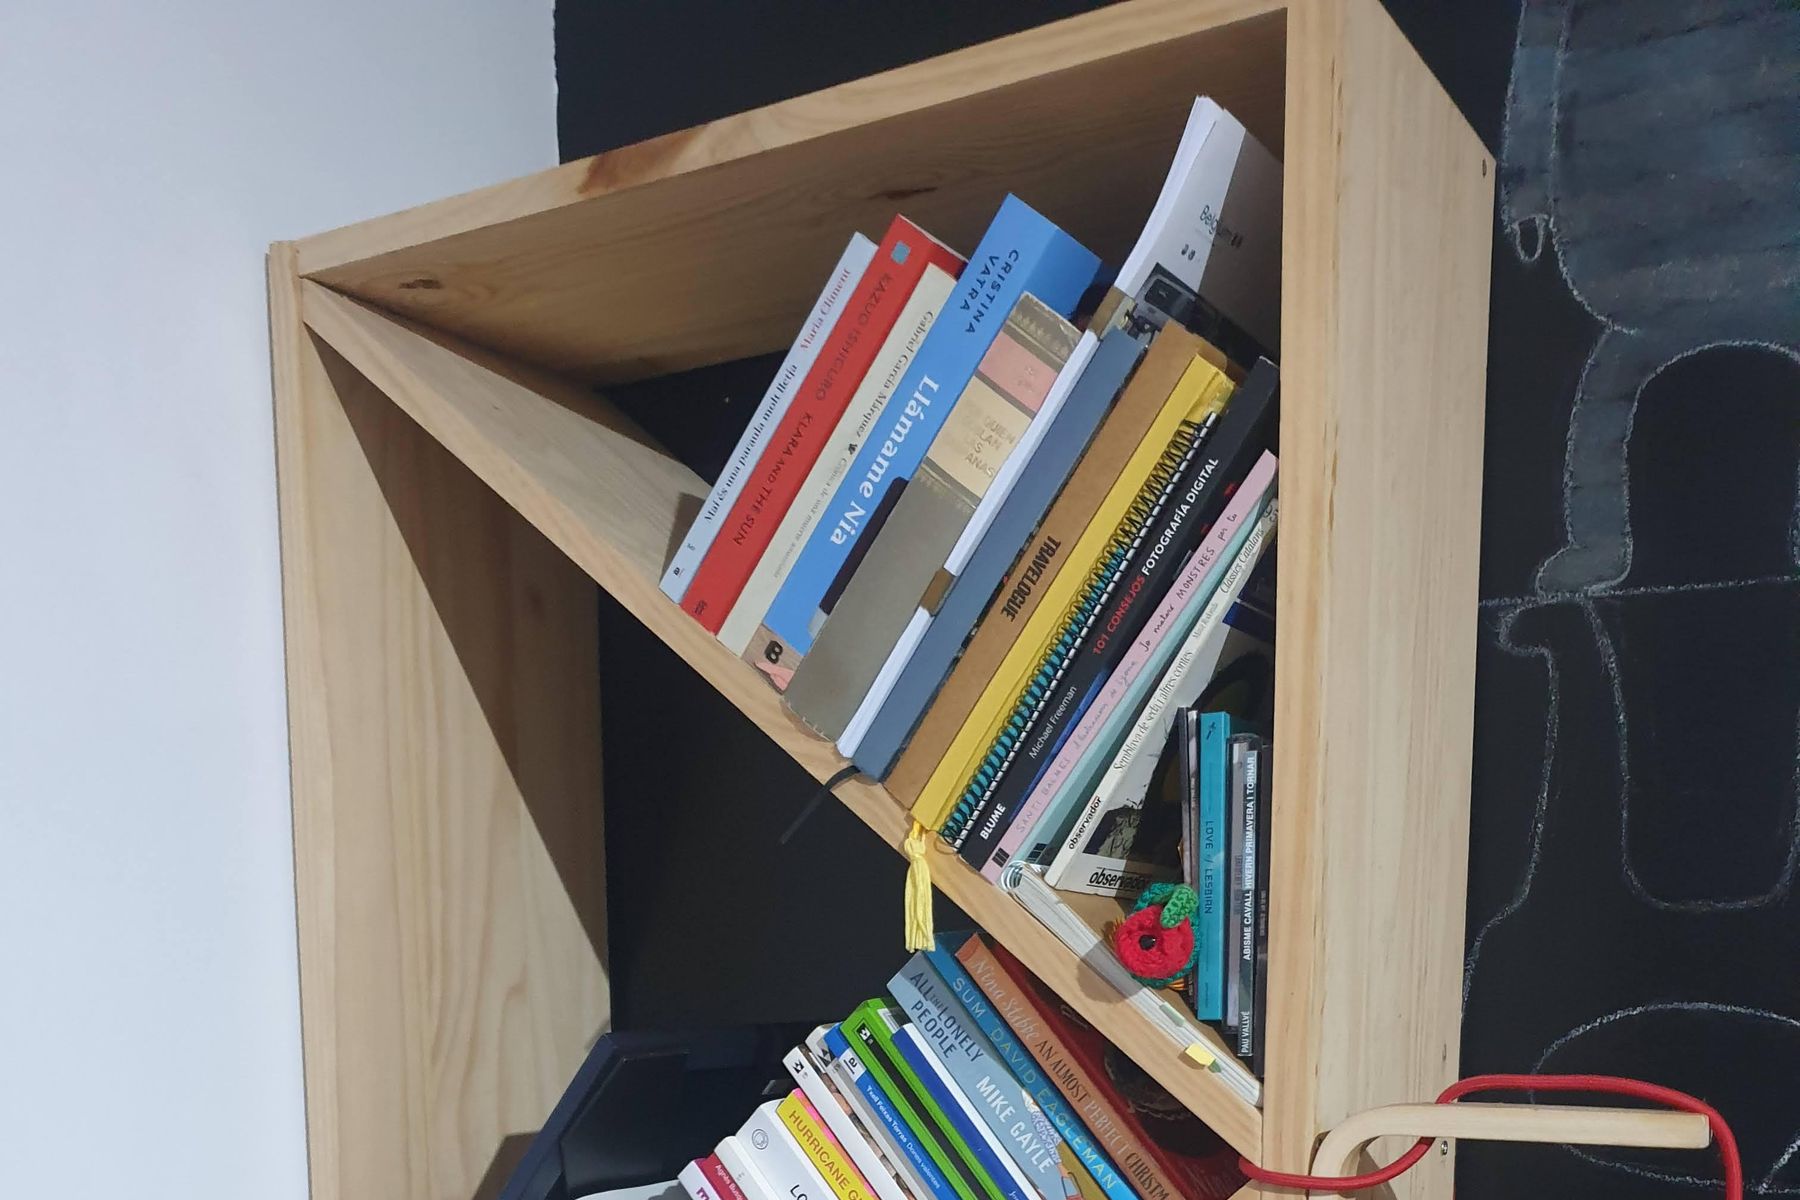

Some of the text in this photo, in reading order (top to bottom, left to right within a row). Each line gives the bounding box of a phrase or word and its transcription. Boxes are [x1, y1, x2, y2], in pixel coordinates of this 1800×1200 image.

[800, 269, 850, 349] Maria Climent
[960, 256, 999, 310] VATRA
[966, 250, 1019, 333] CRISTINA
[856, 311, 933, 437] Gabriel García Márquez
[717, 365, 797, 501] és paraula lletja
[830, 376, 938, 544] Llámame Nia
[733, 412, 813, 546] KLARA AND THE SUN
[1001, 536, 1061, 621] TRAVELOGUE
[1107, 459, 1218, 632] CONSEJOS FOTOGRAFÍA DIGITAL
[1029, 686, 1077, 759] Michael Freeman
[1111, 651, 1194, 771] Semblava altres contes
[980, 803, 1006, 840] BLUME
[1066, 796, 1101, 849] observador
[1205, 820, 1214, 849] LOVE
[1242, 757, 1256, 960] ABISME CAVALL HIVERN PRIMAVERA TORNAR
[910, 972, 983, 1061] ALL LONELY
[911, 1000, 956, 1058] PEOPLE
[1240, 1011, 1250, 1053] PAU VALLVÉ
[953, 978, 1116, 1189] SUM DAVID EAGLEMAN
[976, 1076, 1055, 1173] MIKE GAYLE
[1050, 1059, 1090, 1102] ALMOST
[1083, 1100, 1131, 1155] PERFECT
[715, 1162, 734, 1184] Agnès
[789, 1111, 850, 1190] HURRICANE
[891, 1120, 940, 1189] Torras Dones valentes
